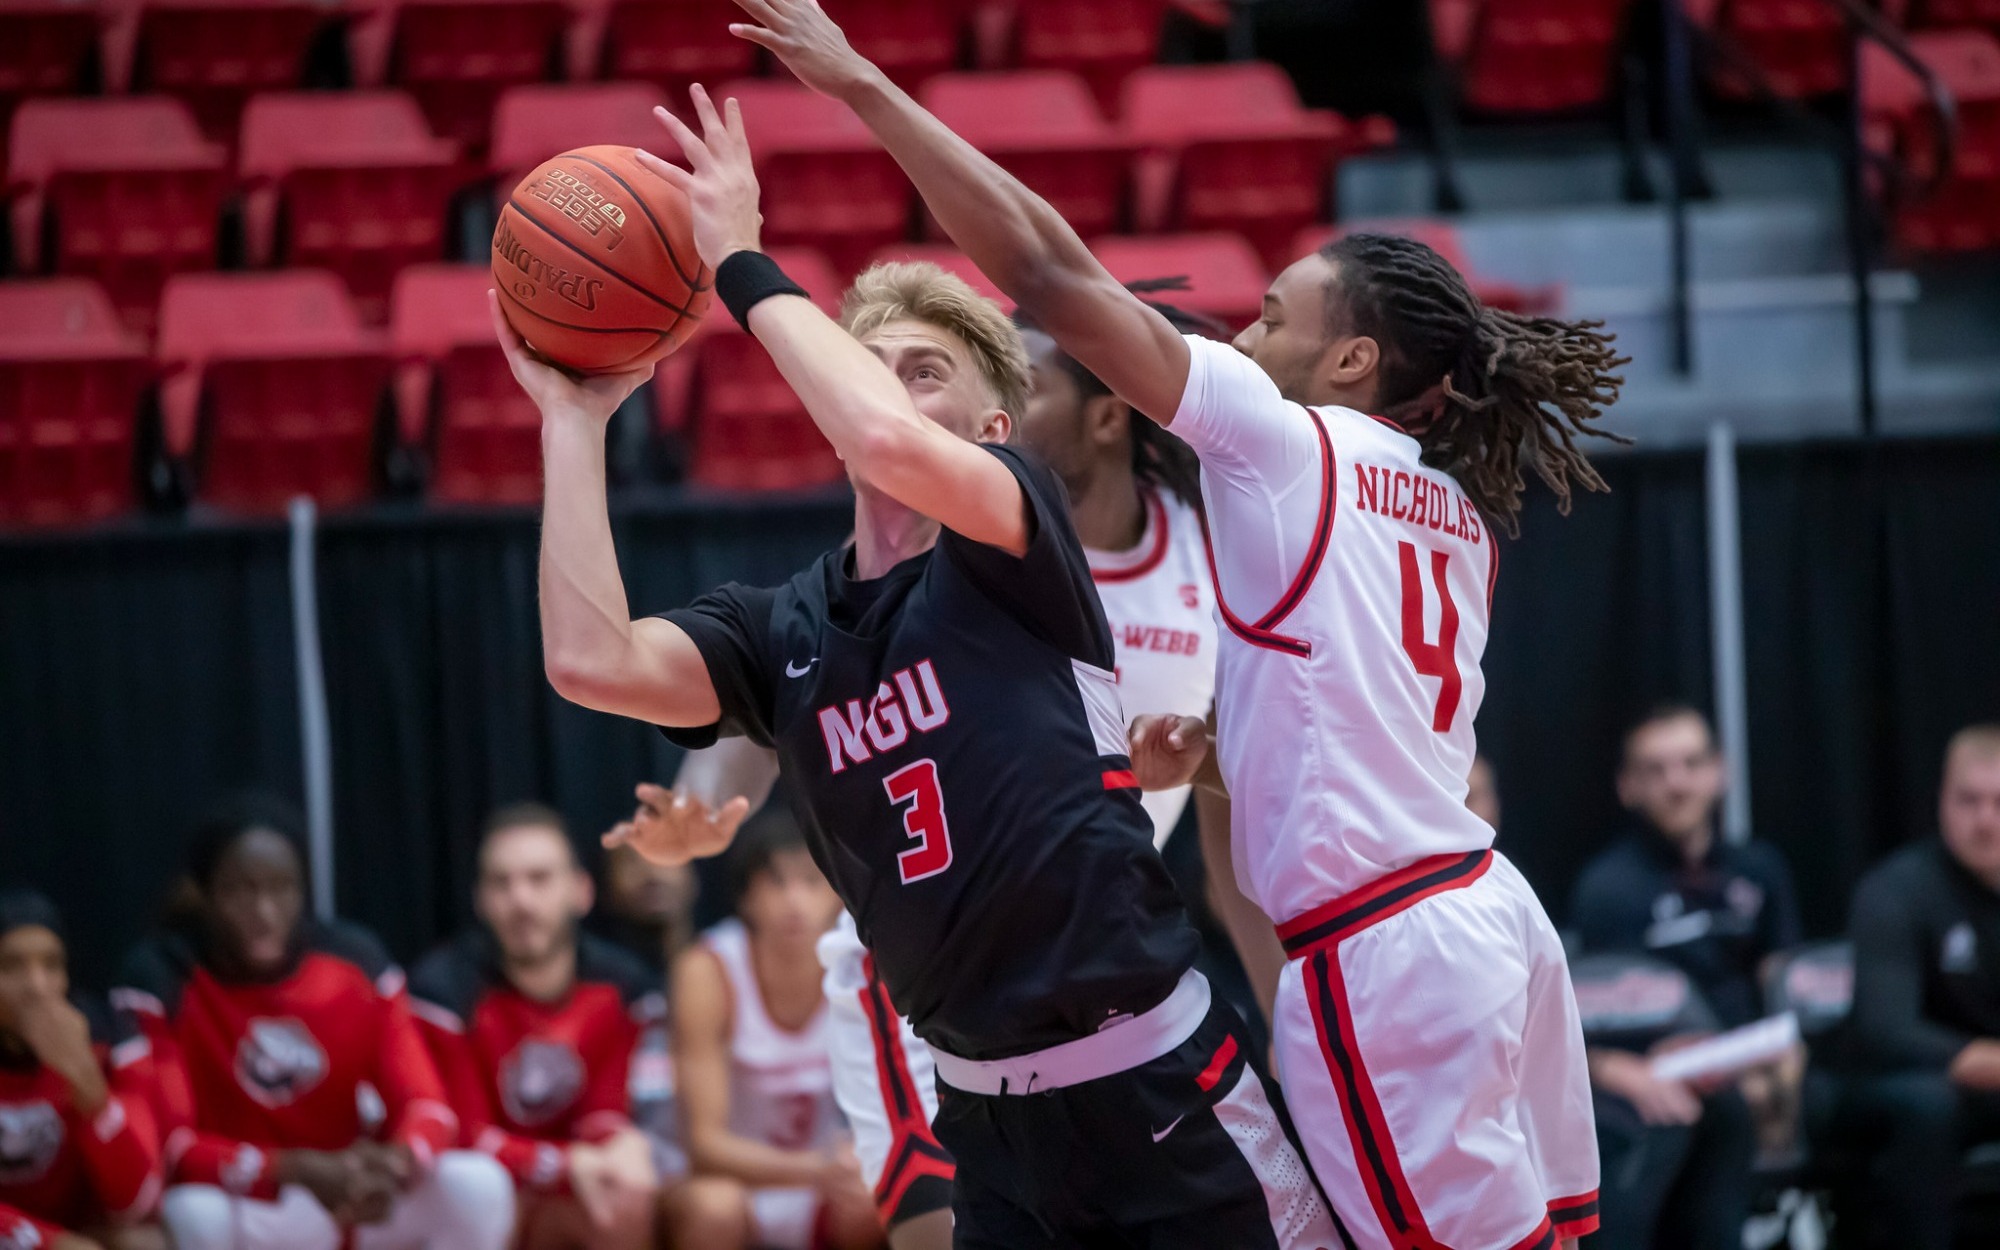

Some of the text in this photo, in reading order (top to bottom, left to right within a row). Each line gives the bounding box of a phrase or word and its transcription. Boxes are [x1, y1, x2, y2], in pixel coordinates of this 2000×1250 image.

[493, 216, 604, 311] SPALDING
[1354, 462, 1481, 545] NICHOLAS
[1109, 623, 1201, 657] -WEBB
[1397, 540, 1463, 733] 4
[816, 657, 951, 775] NGU
[882, 757, 953, 885] 3
